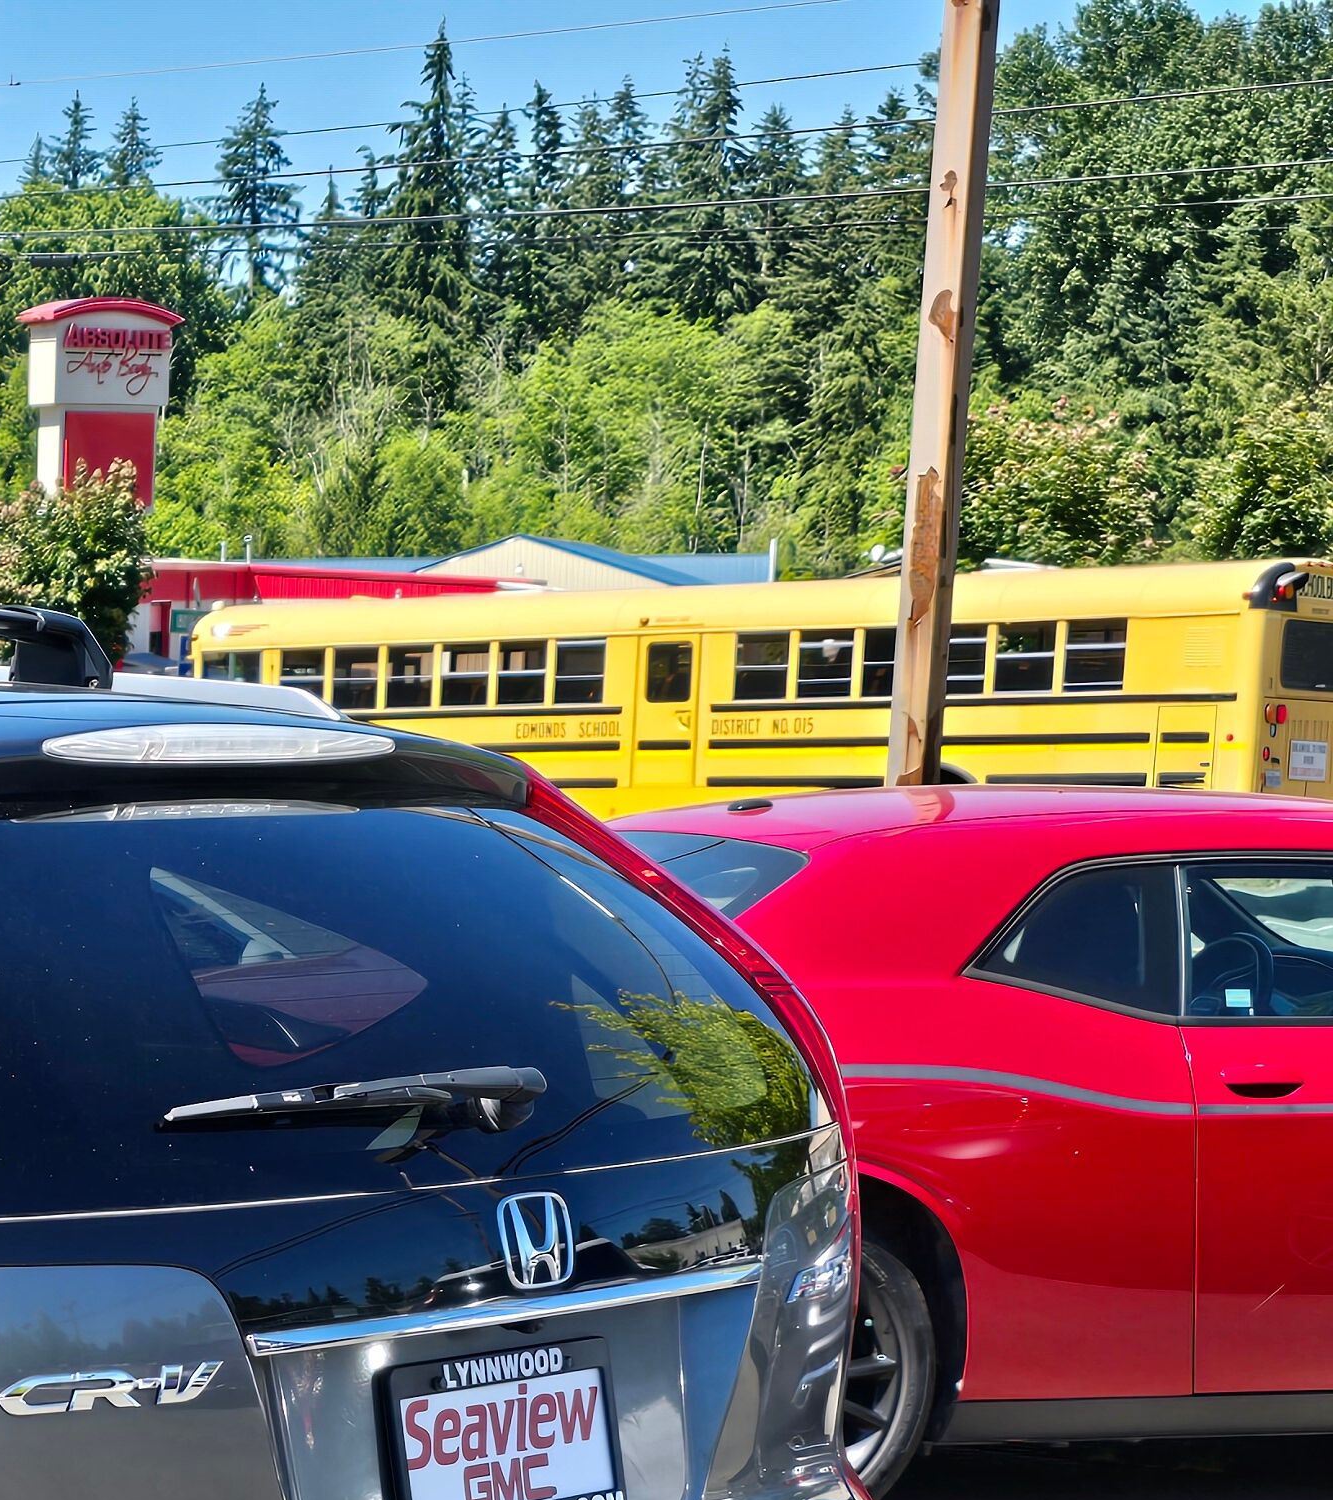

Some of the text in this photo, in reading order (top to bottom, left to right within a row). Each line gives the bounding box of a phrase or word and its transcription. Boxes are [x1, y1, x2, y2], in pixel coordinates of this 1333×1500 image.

[63, 322, 172, 349] ABSOLUTE
[516, 722, 566, 739] EDMONDS
[579, 720, 622, 738] SCHOOL
[711, 718, 761, 735] DISTRICT
[793, 717, 813, 734] 015
[442, 1347, 563, 1389] LYNNWOOD
[405, 1383, 598, 1470] Seaview
